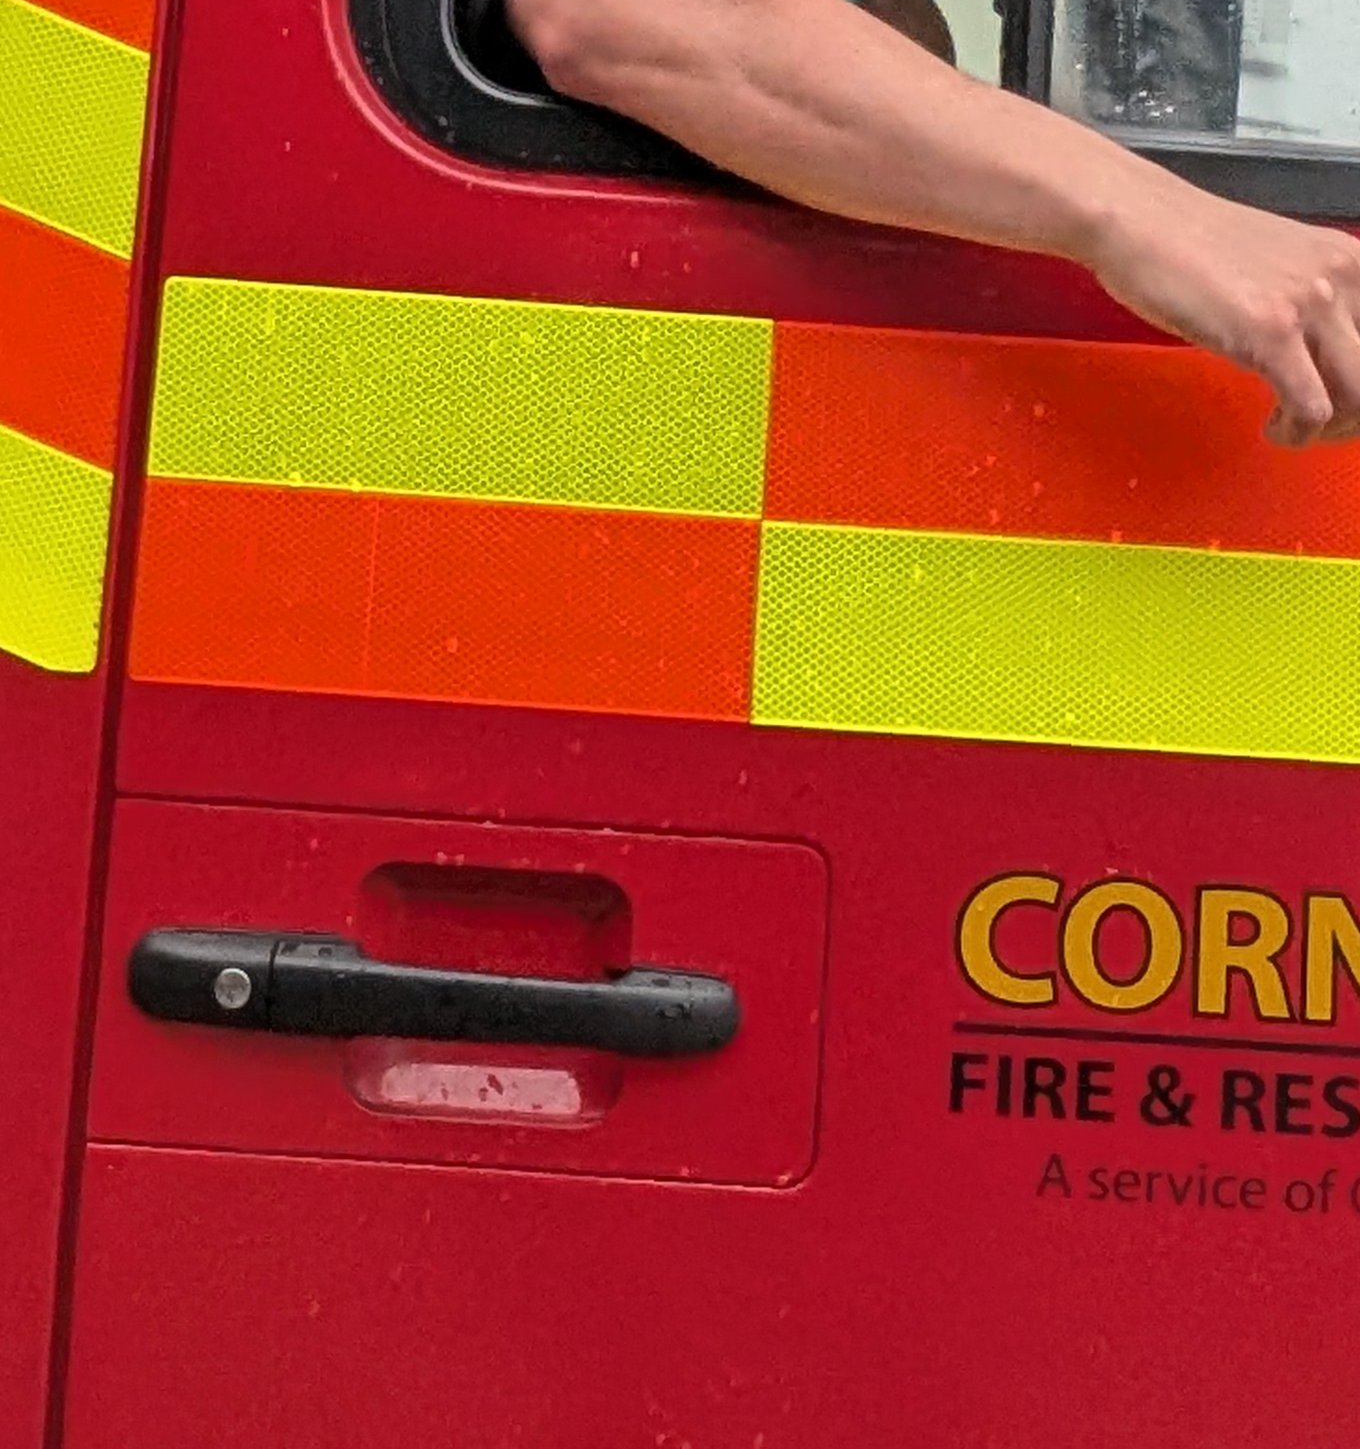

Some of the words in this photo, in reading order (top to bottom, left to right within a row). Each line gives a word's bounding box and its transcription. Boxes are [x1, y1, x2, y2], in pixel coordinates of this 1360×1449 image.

[948, 1052, 1116, 1124] FIRE
[1138, 1064, 1196, 1128] &
[1034, 1152, 1073, 1199] A
[1087, 1162, 1269, 1211] service
[1280, 1167, 1340, 1215] of
